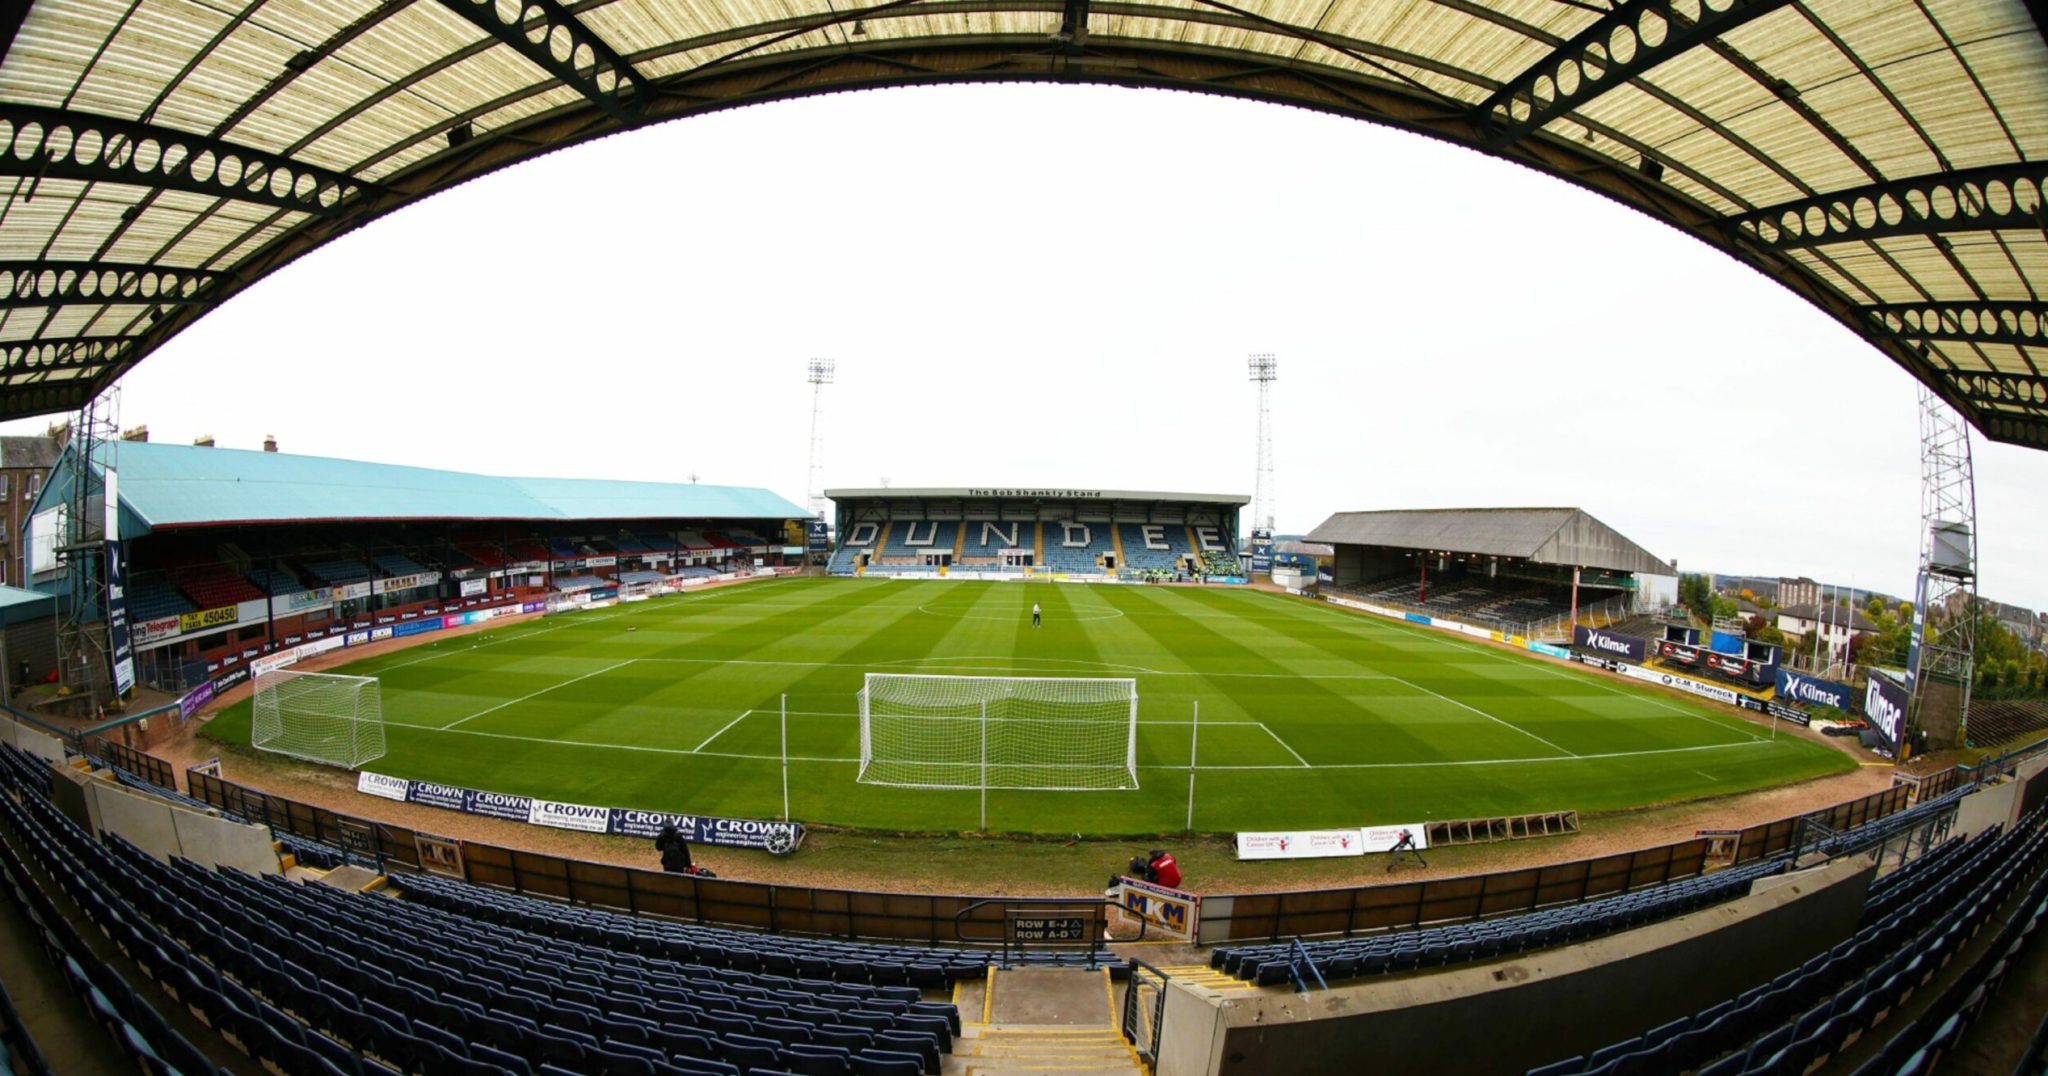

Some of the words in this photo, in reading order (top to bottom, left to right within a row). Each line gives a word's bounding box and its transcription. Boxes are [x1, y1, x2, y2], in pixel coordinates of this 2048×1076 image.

[1015, 489, 1063, 497] Shankly
[203, 608, 235, 624] 450450
[1598, 635, 1630, 654] Kilmac
[1695, 683, 1733, 699] Sturrock
[1800, 683, 1840, 707] Kilmac
[1864, 677, 1901, 742] Kilmac
[367, 774, 407, 790] CROWN
[417, 782, 464, 798] CROWN
[476, 792, 530, 809] CROWN
[543, 802, 607, 819] CROWN
[1127, 892, 1184, 926] MKM
[1016, 919, 1044, 928] ROW
[1048, 919, 1068, 928] E-J
[1016, 930, 1044, 939] ROW
[1048, 930, 1069, 939] A-D
